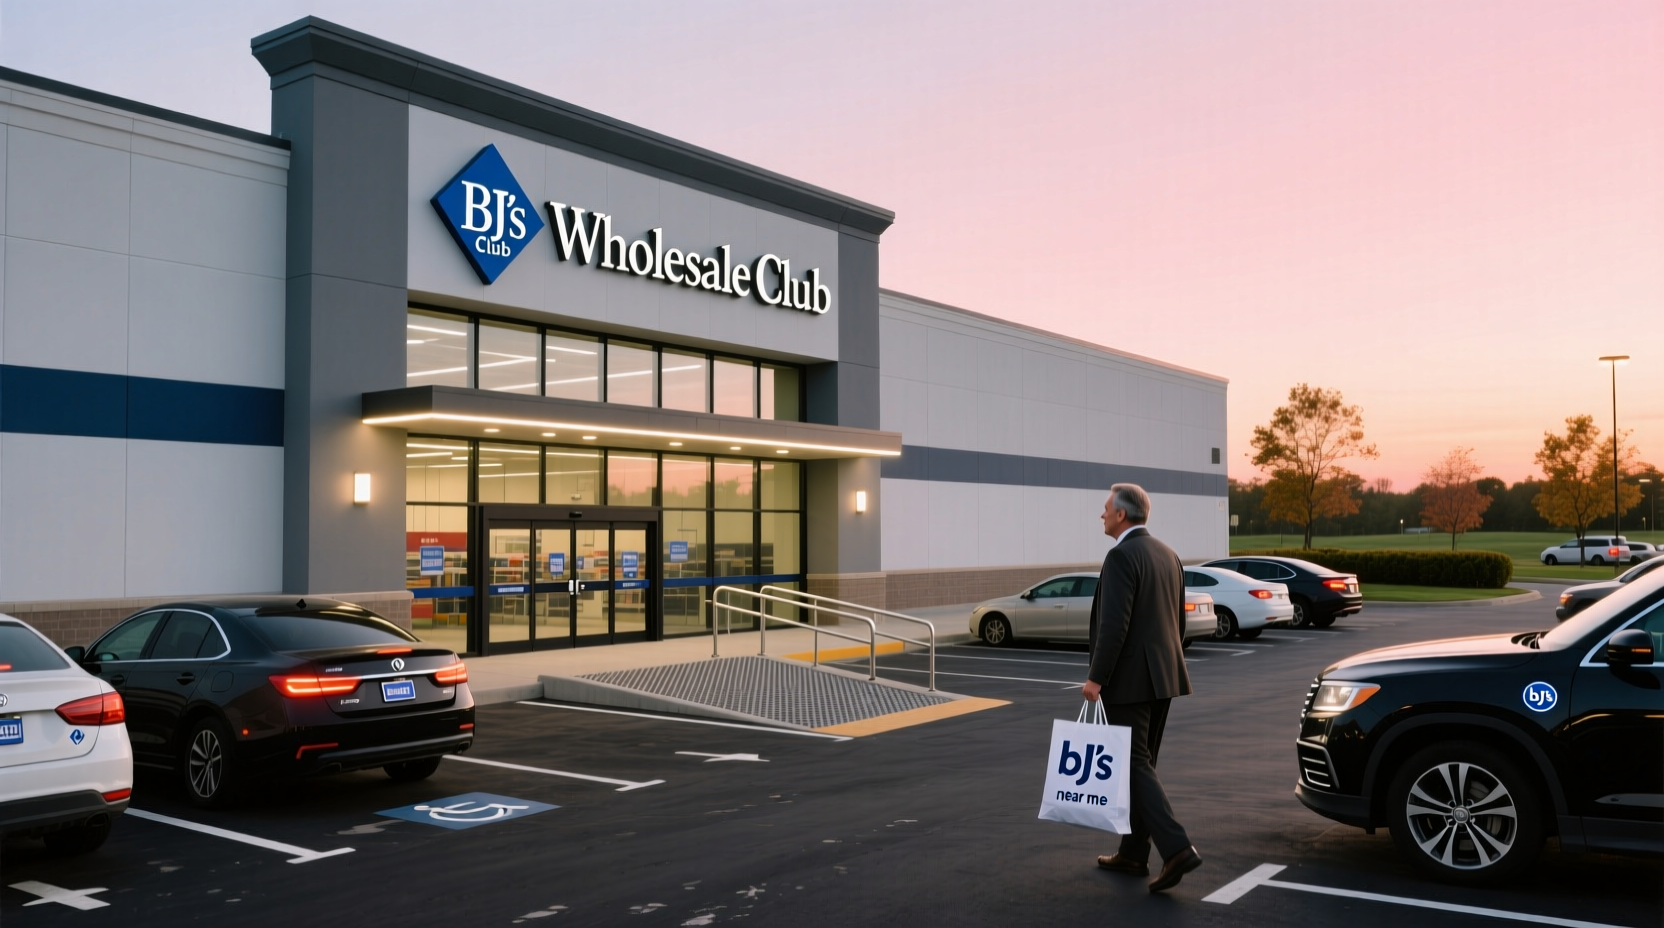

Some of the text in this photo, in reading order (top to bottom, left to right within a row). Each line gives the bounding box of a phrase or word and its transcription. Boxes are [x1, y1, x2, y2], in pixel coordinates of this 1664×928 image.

[461, 180, 527, 242] BJ's
[475, 236, 511, 258] Club
[548, 201, 832, 315] Wholesale Club
[1058, 740, 1114, 785] bJ's
[1056, 790, 1108, 806] near me
